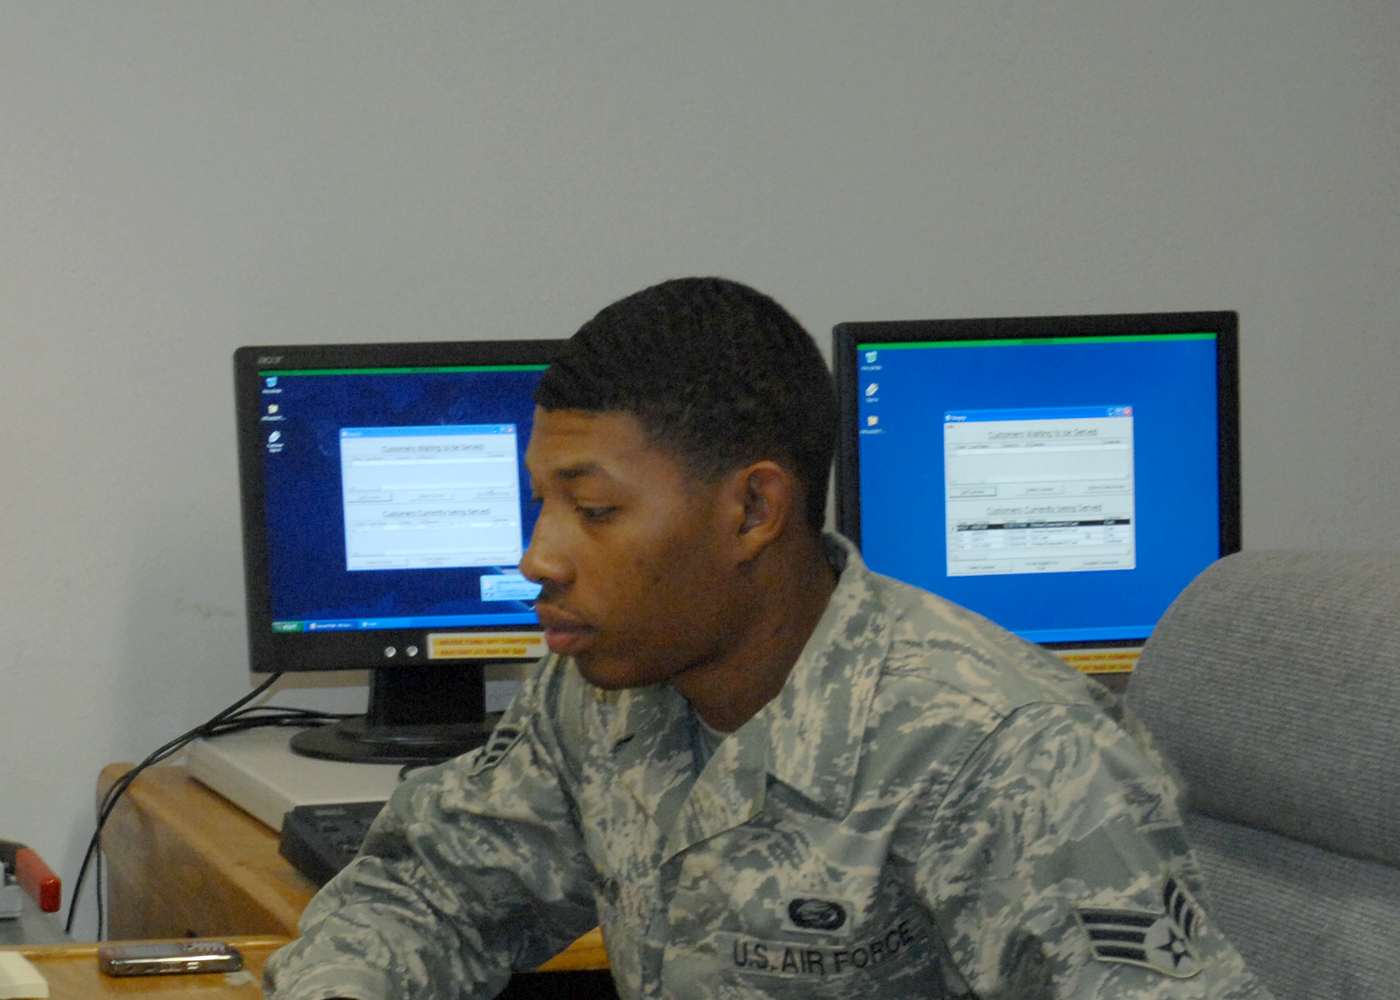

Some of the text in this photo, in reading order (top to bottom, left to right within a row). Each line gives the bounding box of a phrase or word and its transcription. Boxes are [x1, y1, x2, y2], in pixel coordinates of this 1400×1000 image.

[733, 921, 915, 975] U.S. AIR FORCE
